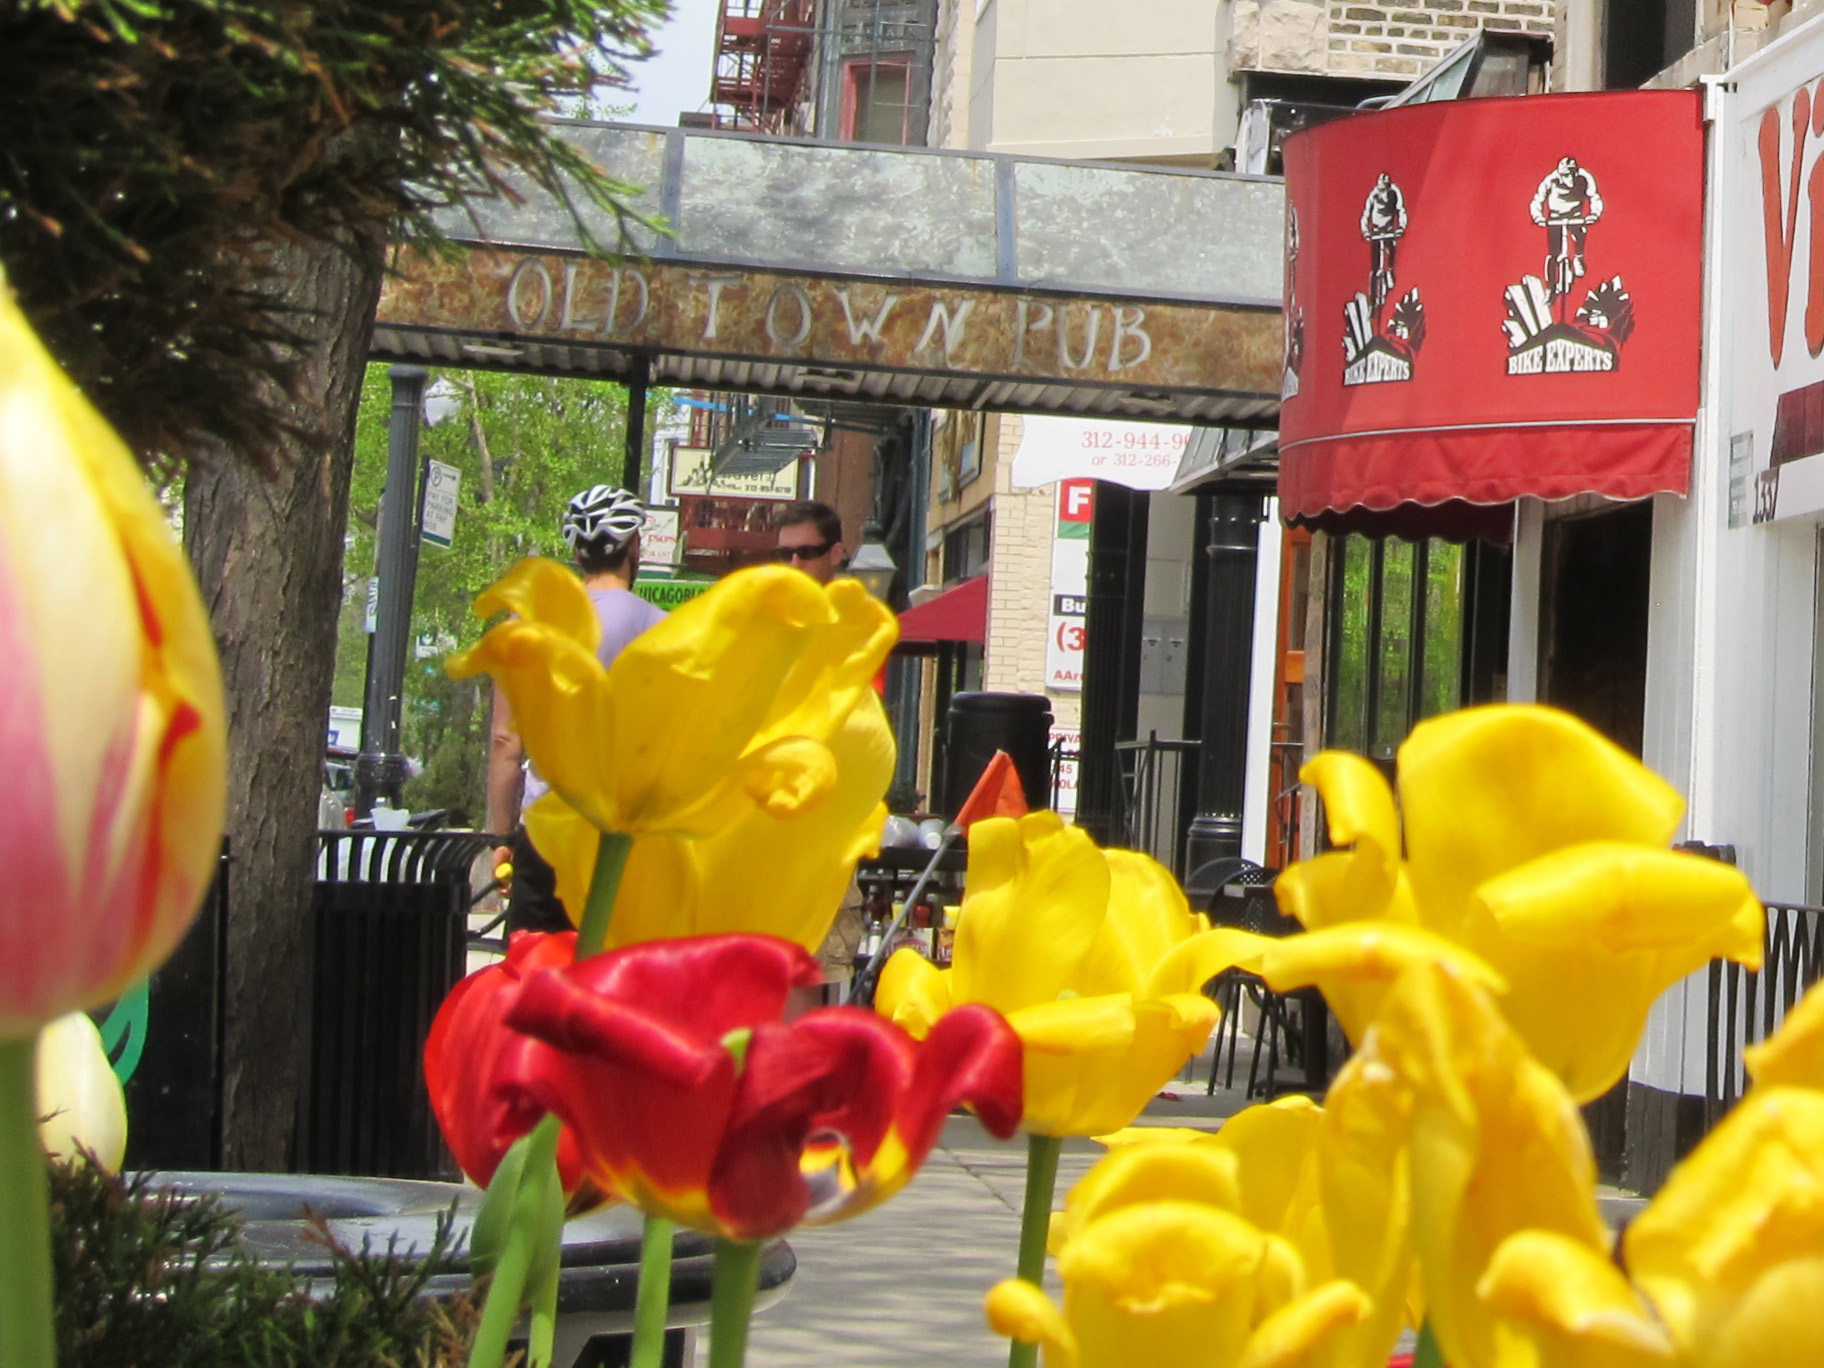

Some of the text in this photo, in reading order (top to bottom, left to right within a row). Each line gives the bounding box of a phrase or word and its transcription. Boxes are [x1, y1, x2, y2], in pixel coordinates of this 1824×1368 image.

[506, 256, 1152, 373] OLD TOWN PUB
[1366, 350, 1410, 383] EXPERTS
[1508, 338, 1613, 374] BIKE EXPERTS
[1092, 454, 1181, 467] or 312-266-
